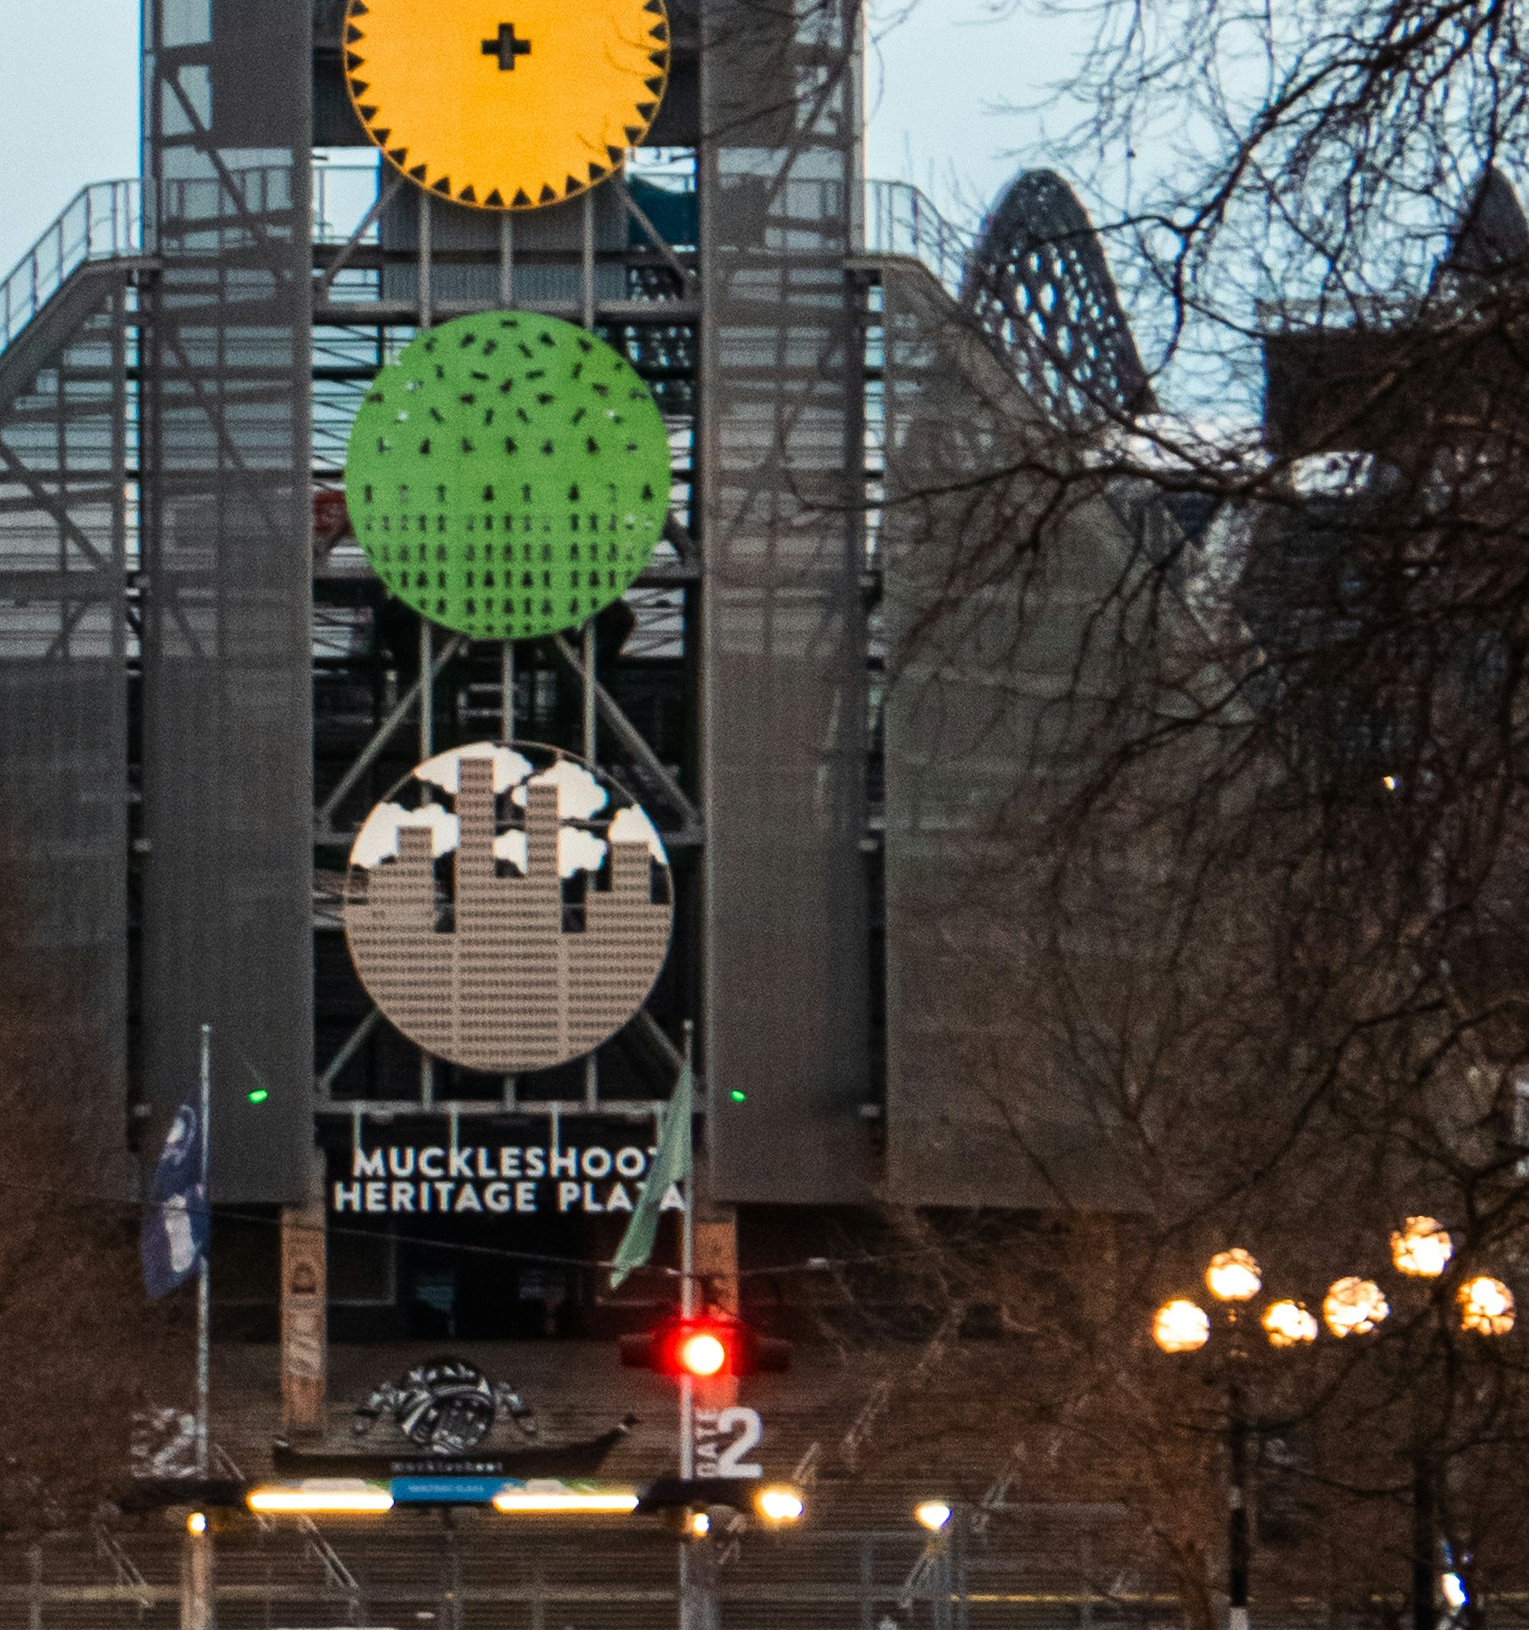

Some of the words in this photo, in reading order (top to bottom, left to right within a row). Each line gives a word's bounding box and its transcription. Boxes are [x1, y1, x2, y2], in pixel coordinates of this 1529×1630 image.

[333, 1181, 538, 1213] HERITAGE
[558, 1181, 685, 1213] PLAA
[717, 1406, 763, 1478] 2
